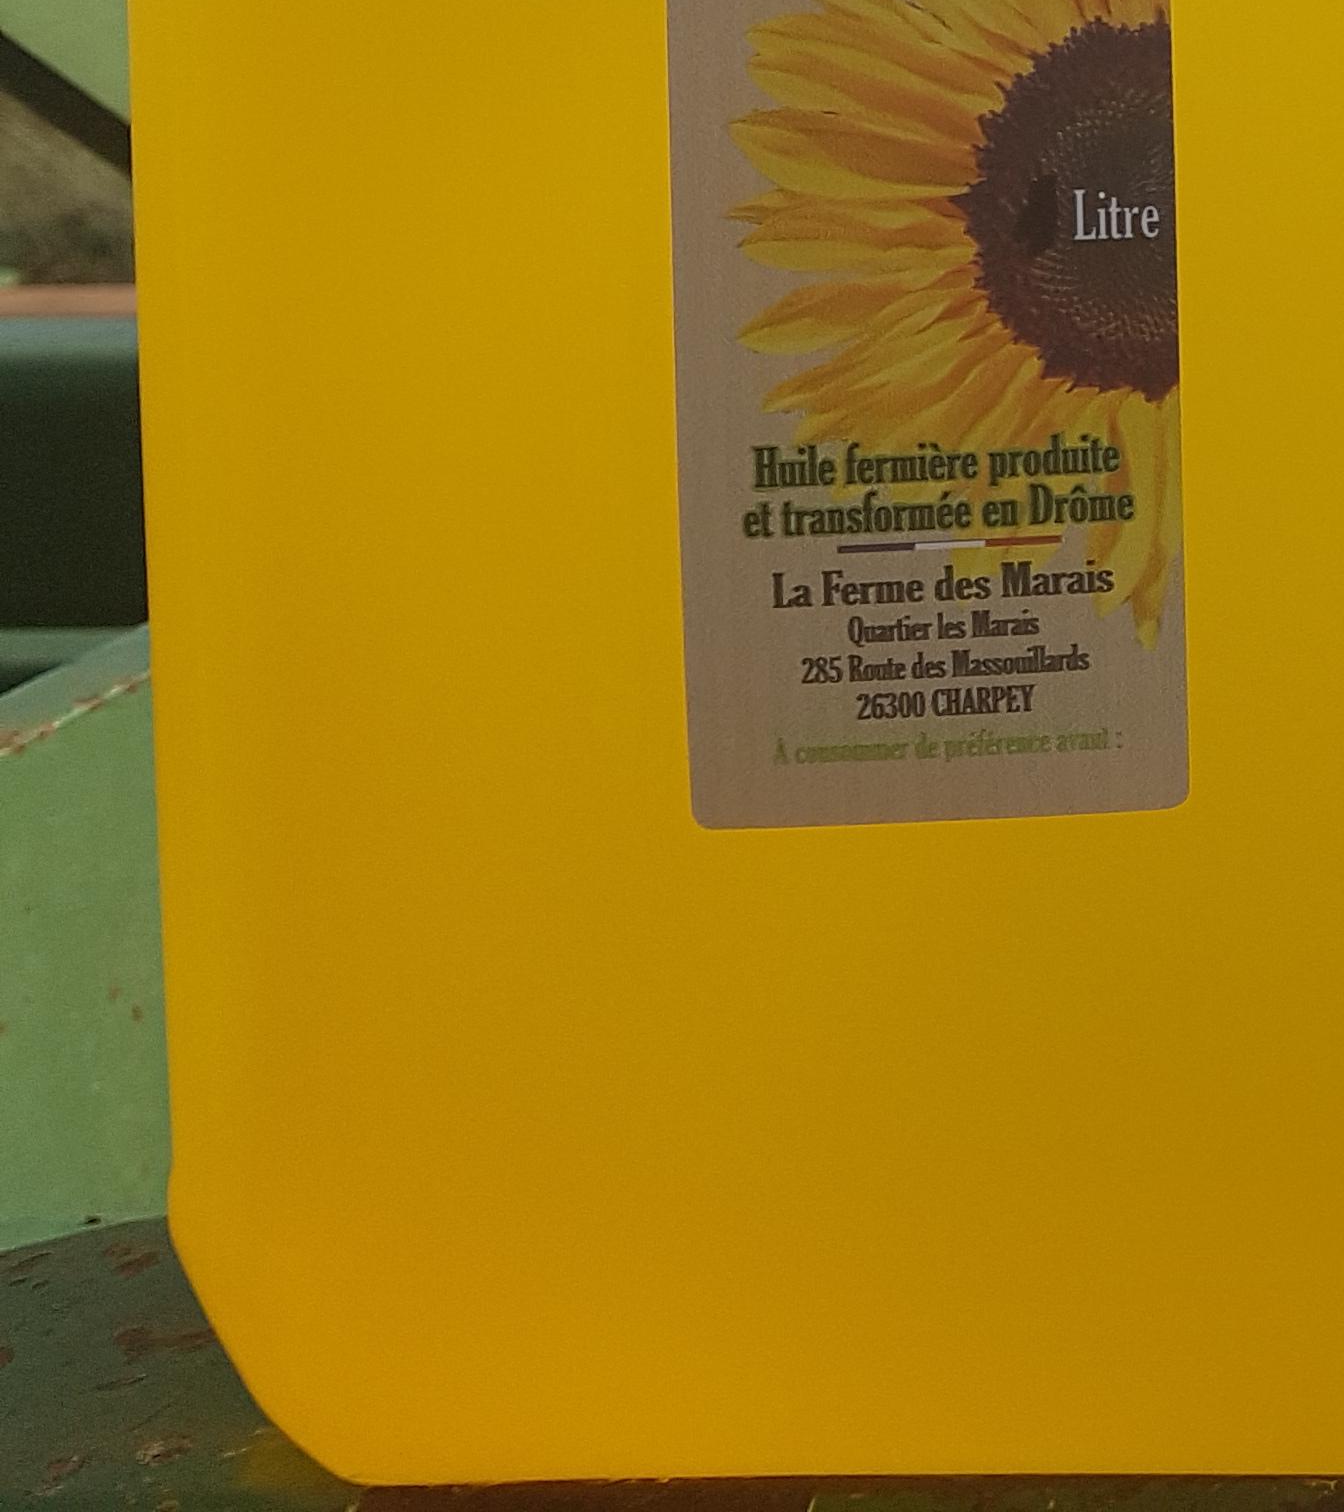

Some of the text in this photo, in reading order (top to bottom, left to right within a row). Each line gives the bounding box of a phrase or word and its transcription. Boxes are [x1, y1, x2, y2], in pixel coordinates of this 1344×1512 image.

[1073, 189, 1161, 241] Litre
[751, 434, 1121, 489] Huile fermière produite
[742, 483, 1135, 538] et transformée en Drôme
[772, 559, 1115, 609] La Ferme des Marais
[847, 609, 1040, 647] Quartier les Marais
[801, 644, 1090, 685] 285 Route des Massouillards
[856, 684, 1036, 721] 26300 CHARPEY
